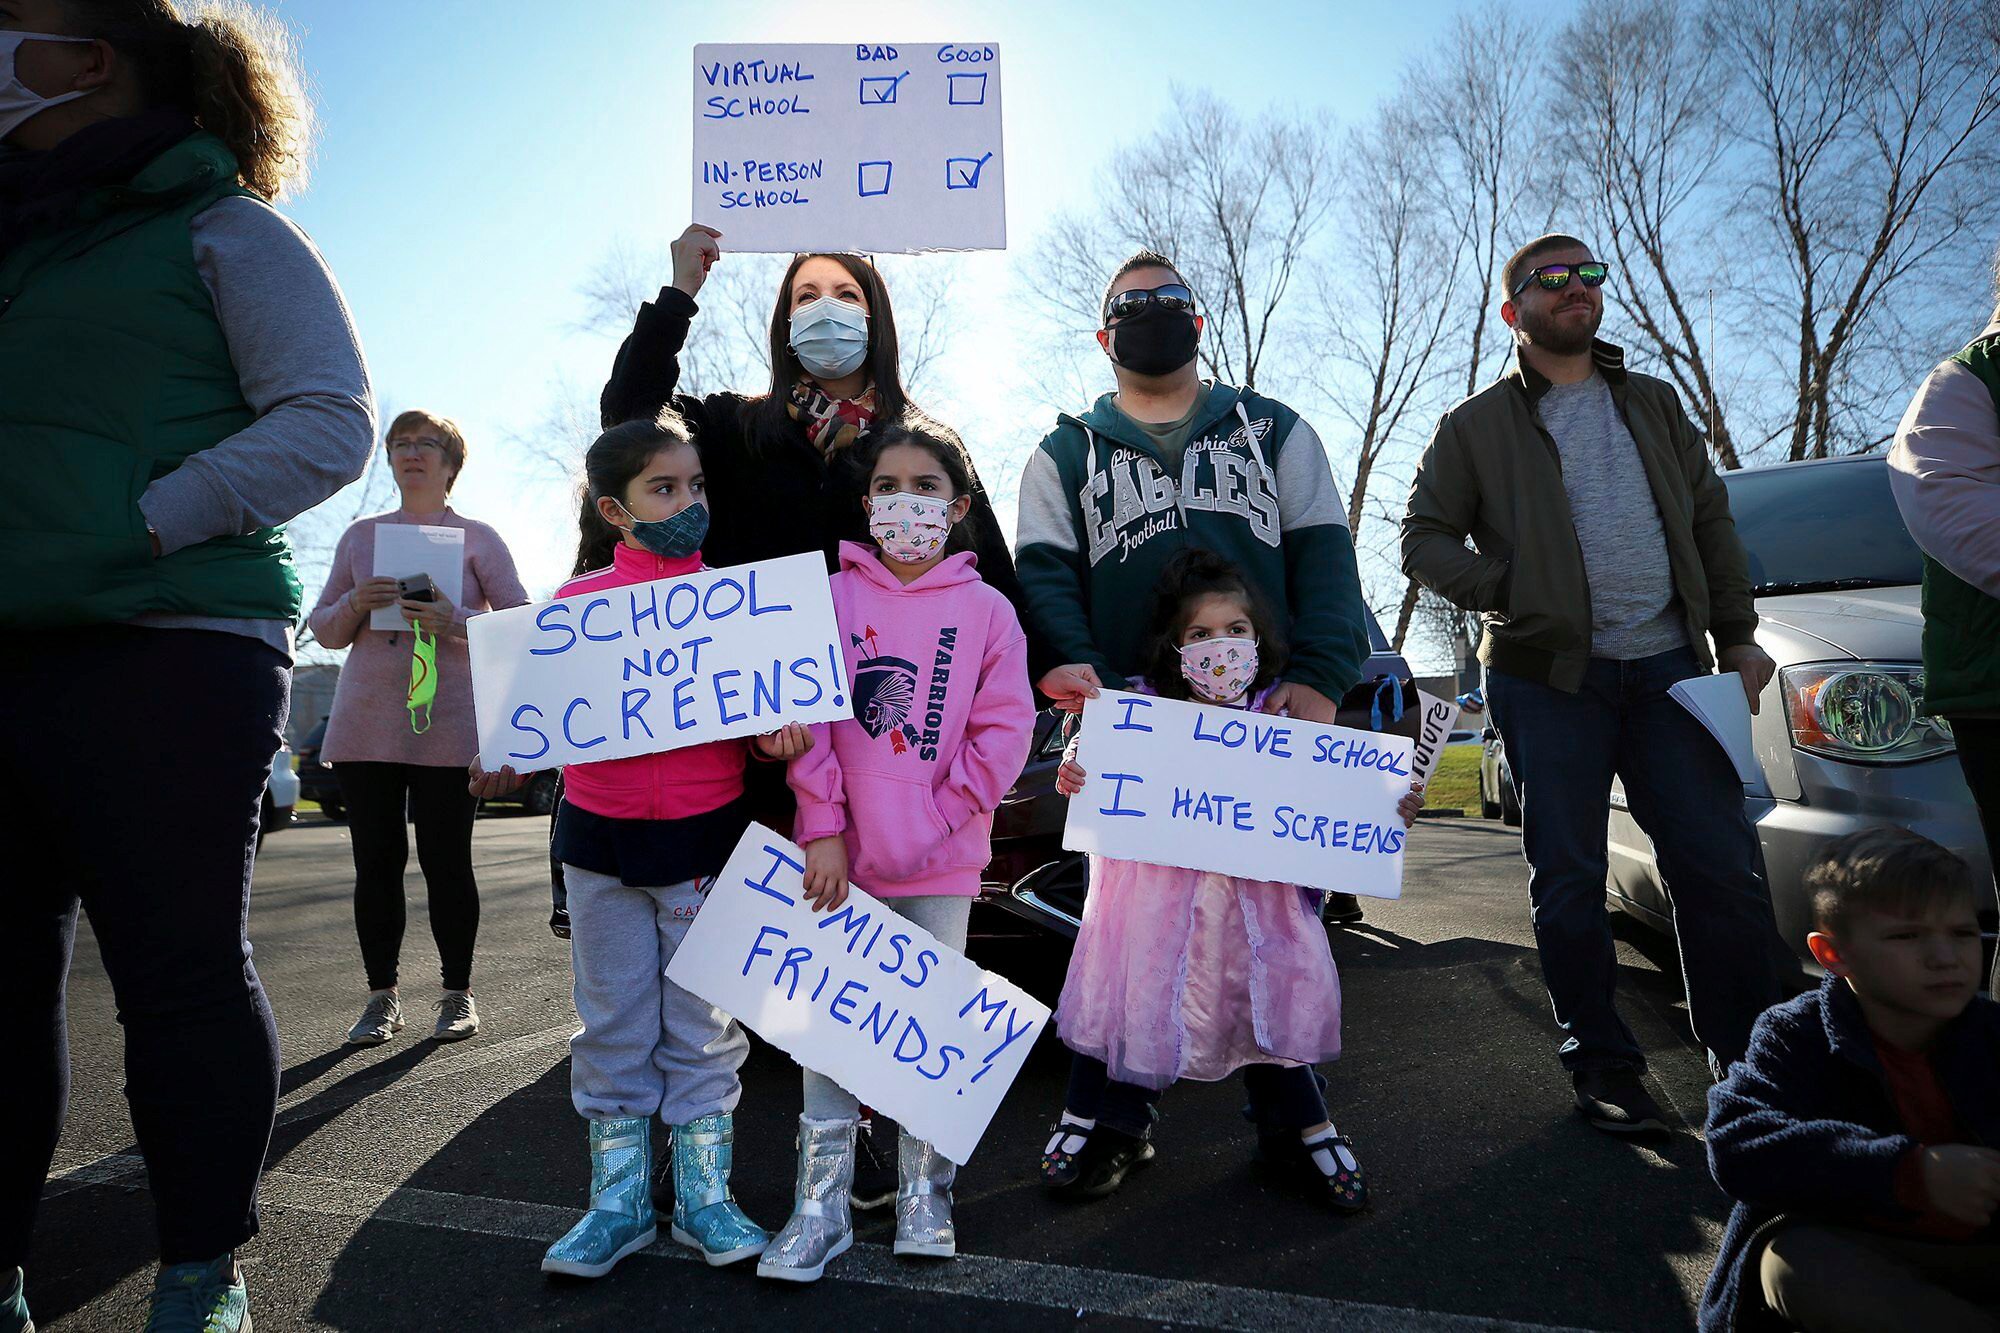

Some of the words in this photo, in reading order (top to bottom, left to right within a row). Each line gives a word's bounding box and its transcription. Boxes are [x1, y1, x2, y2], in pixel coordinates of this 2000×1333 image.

[703, 59, 815, 88] VIRTUAL
[856, 45, 898, 62] BAD
[936, 44, 994, 64] GOOD
[703, 95, 810, 121] SCHOOL
[703, 159, 823, 185] IN-PERSON
[720, 189, 809, 209] SCHOOL
[1079, 451, 1281, 568] EAGLES
[1118, 510, 1178, 563] Football
[529, 570, 793, 657] SCHOOL
[622, 635, 714, 682] NOT
[919, 627, 958, 762] WARRIORS
[507, 643, 845, 761] SCREENS!
[1112, 697, 1153, 733] I
[1192, 712, 1293, 759] LOVE
[1311, 733, 1409, 777] SCHOOL
[1098, 772, 1148, 818] I
[1171, 787, 1256, 832] HATE
[1272, 805, 1406, 855] SCREENS
[743, 843, 805, 907] I
[817, 905, 940, 989] MISS
[958, 987, 1033, 1064] MY
[742, 925, 994, 1096] FRIENDS!
